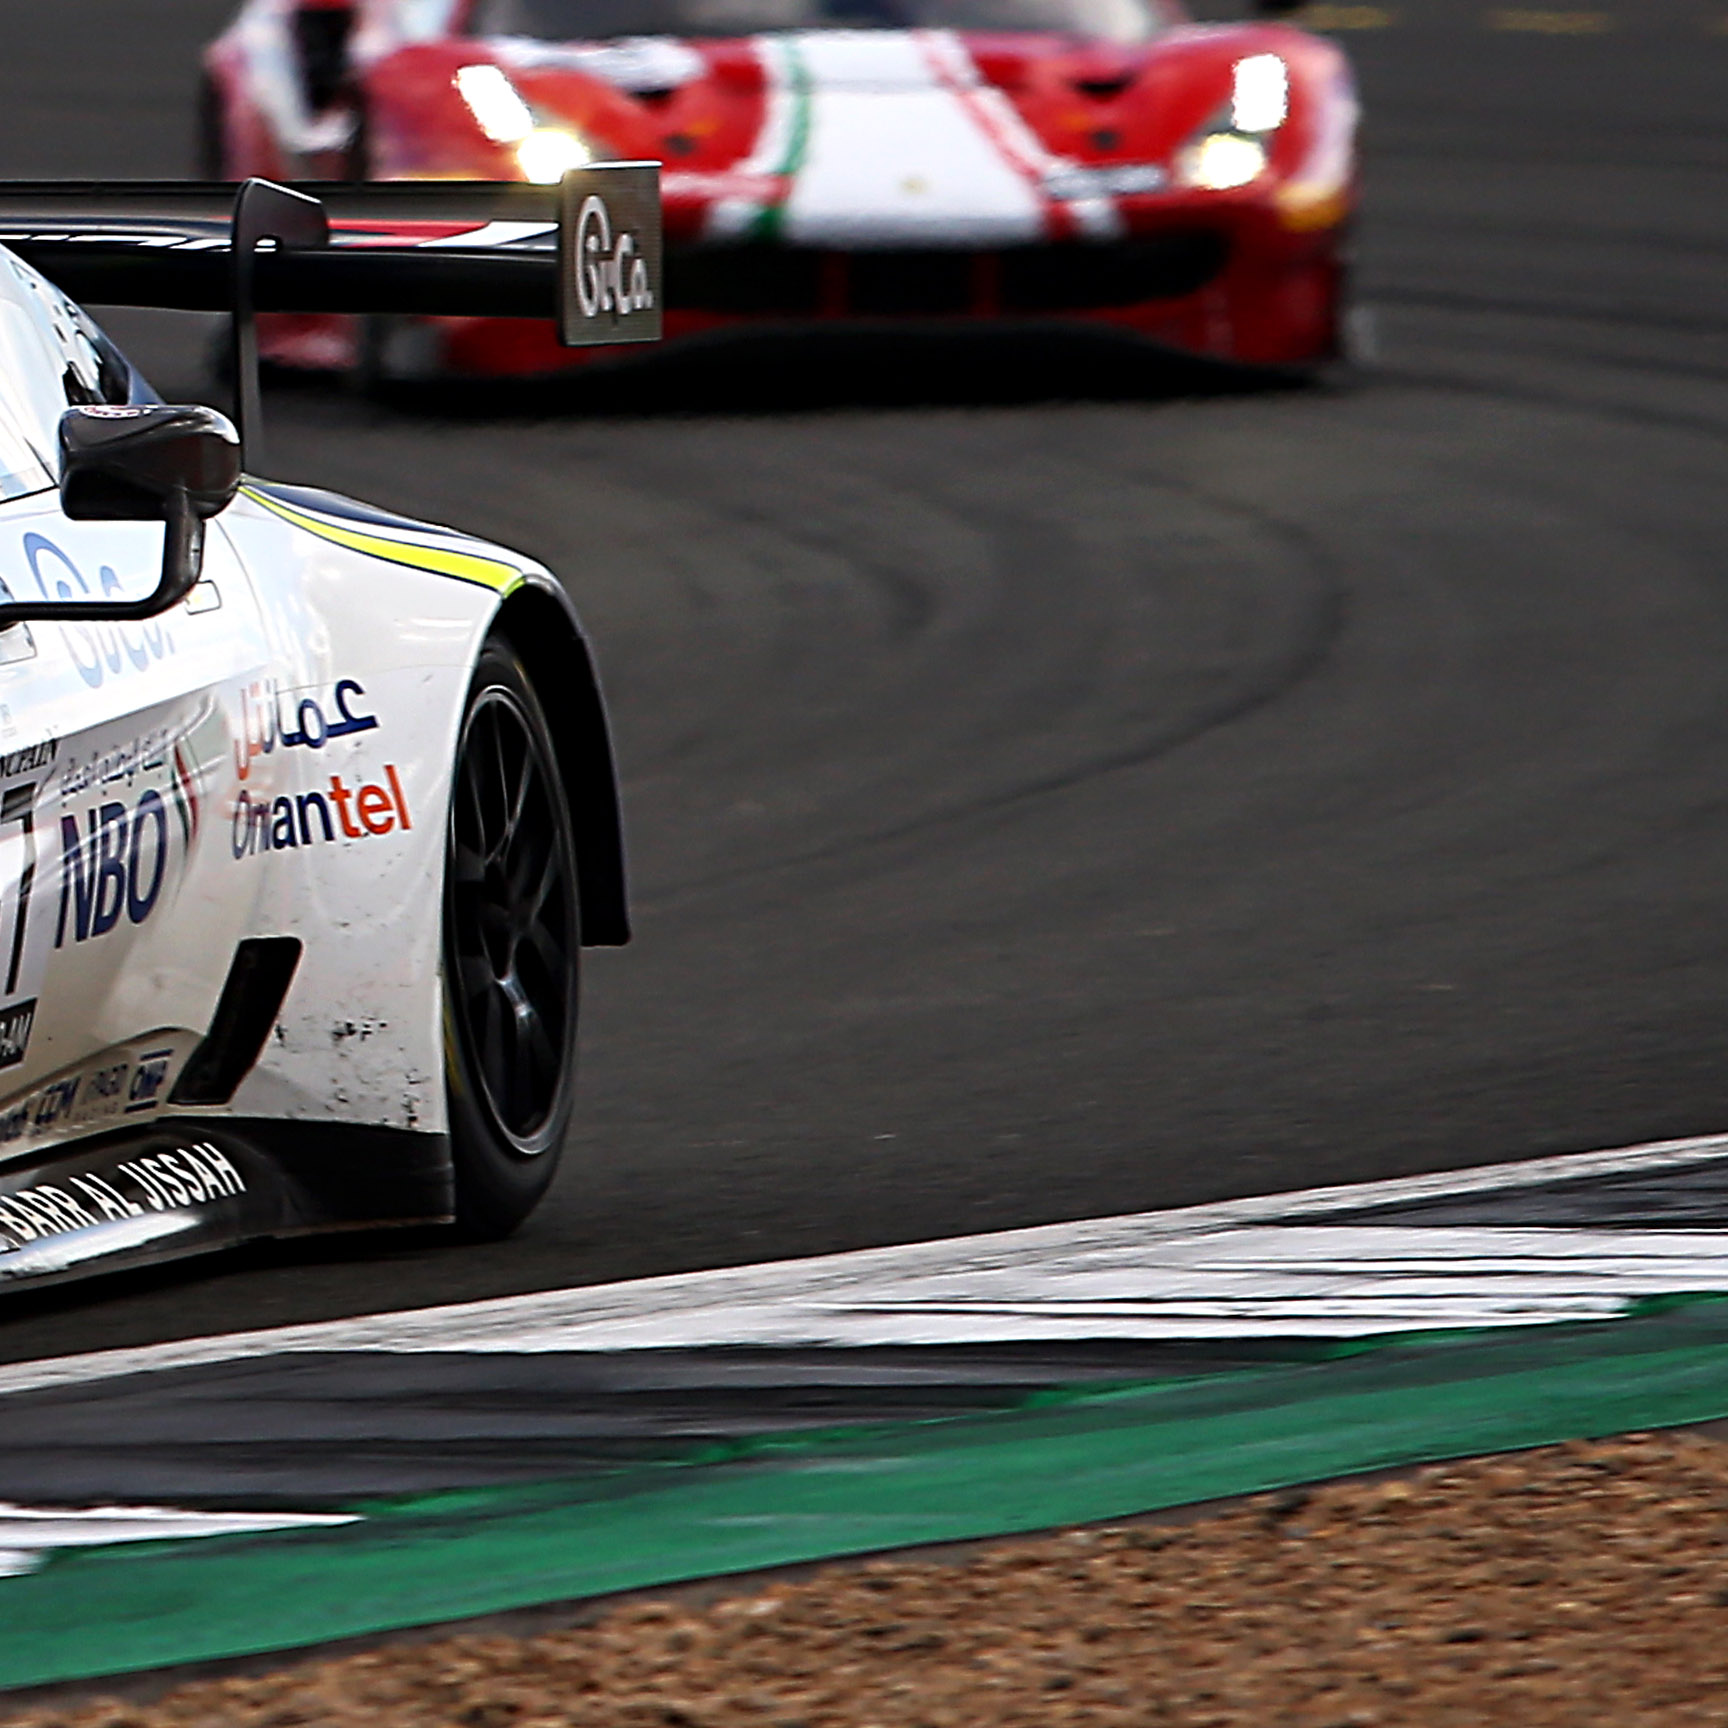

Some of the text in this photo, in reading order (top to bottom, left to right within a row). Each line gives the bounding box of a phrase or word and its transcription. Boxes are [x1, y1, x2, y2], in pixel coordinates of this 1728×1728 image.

[233, 764, 411, 860] Omantel
[54, 789, 167, 949] NBO
[70, 1173, 141, 1221] AL
[119, 1142, 246, 1212] JISSAH
